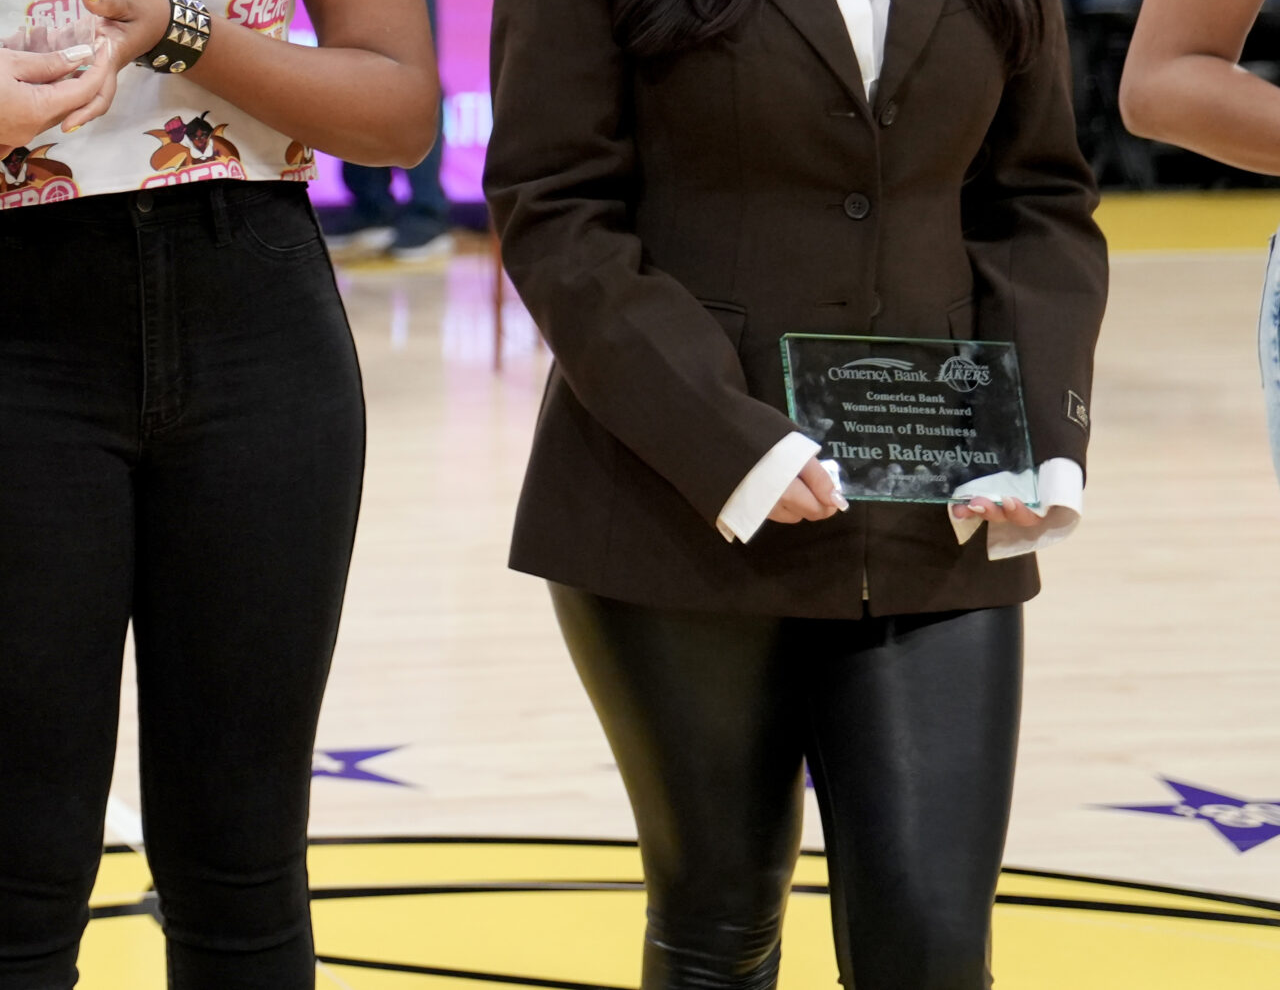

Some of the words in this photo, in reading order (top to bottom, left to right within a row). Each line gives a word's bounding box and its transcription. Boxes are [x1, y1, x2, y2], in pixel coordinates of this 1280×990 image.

[894, 370, 930, 382] Bank
[935, 363, 992, 385] LAKERS
[866, 391, 916, 402] Comerica
[918, 393, 945, 403] Bank
[889, 404, 936, 415] Business
[938, 406, 972, 416] Award
[843, 420, 894, 435] Woman
[897, 423, 913, 435] of
[915, 424, 977, 437] Business
[828, 441, 883, 460] Tirue
[887, 443, 1000, 467] Rafayelyan
